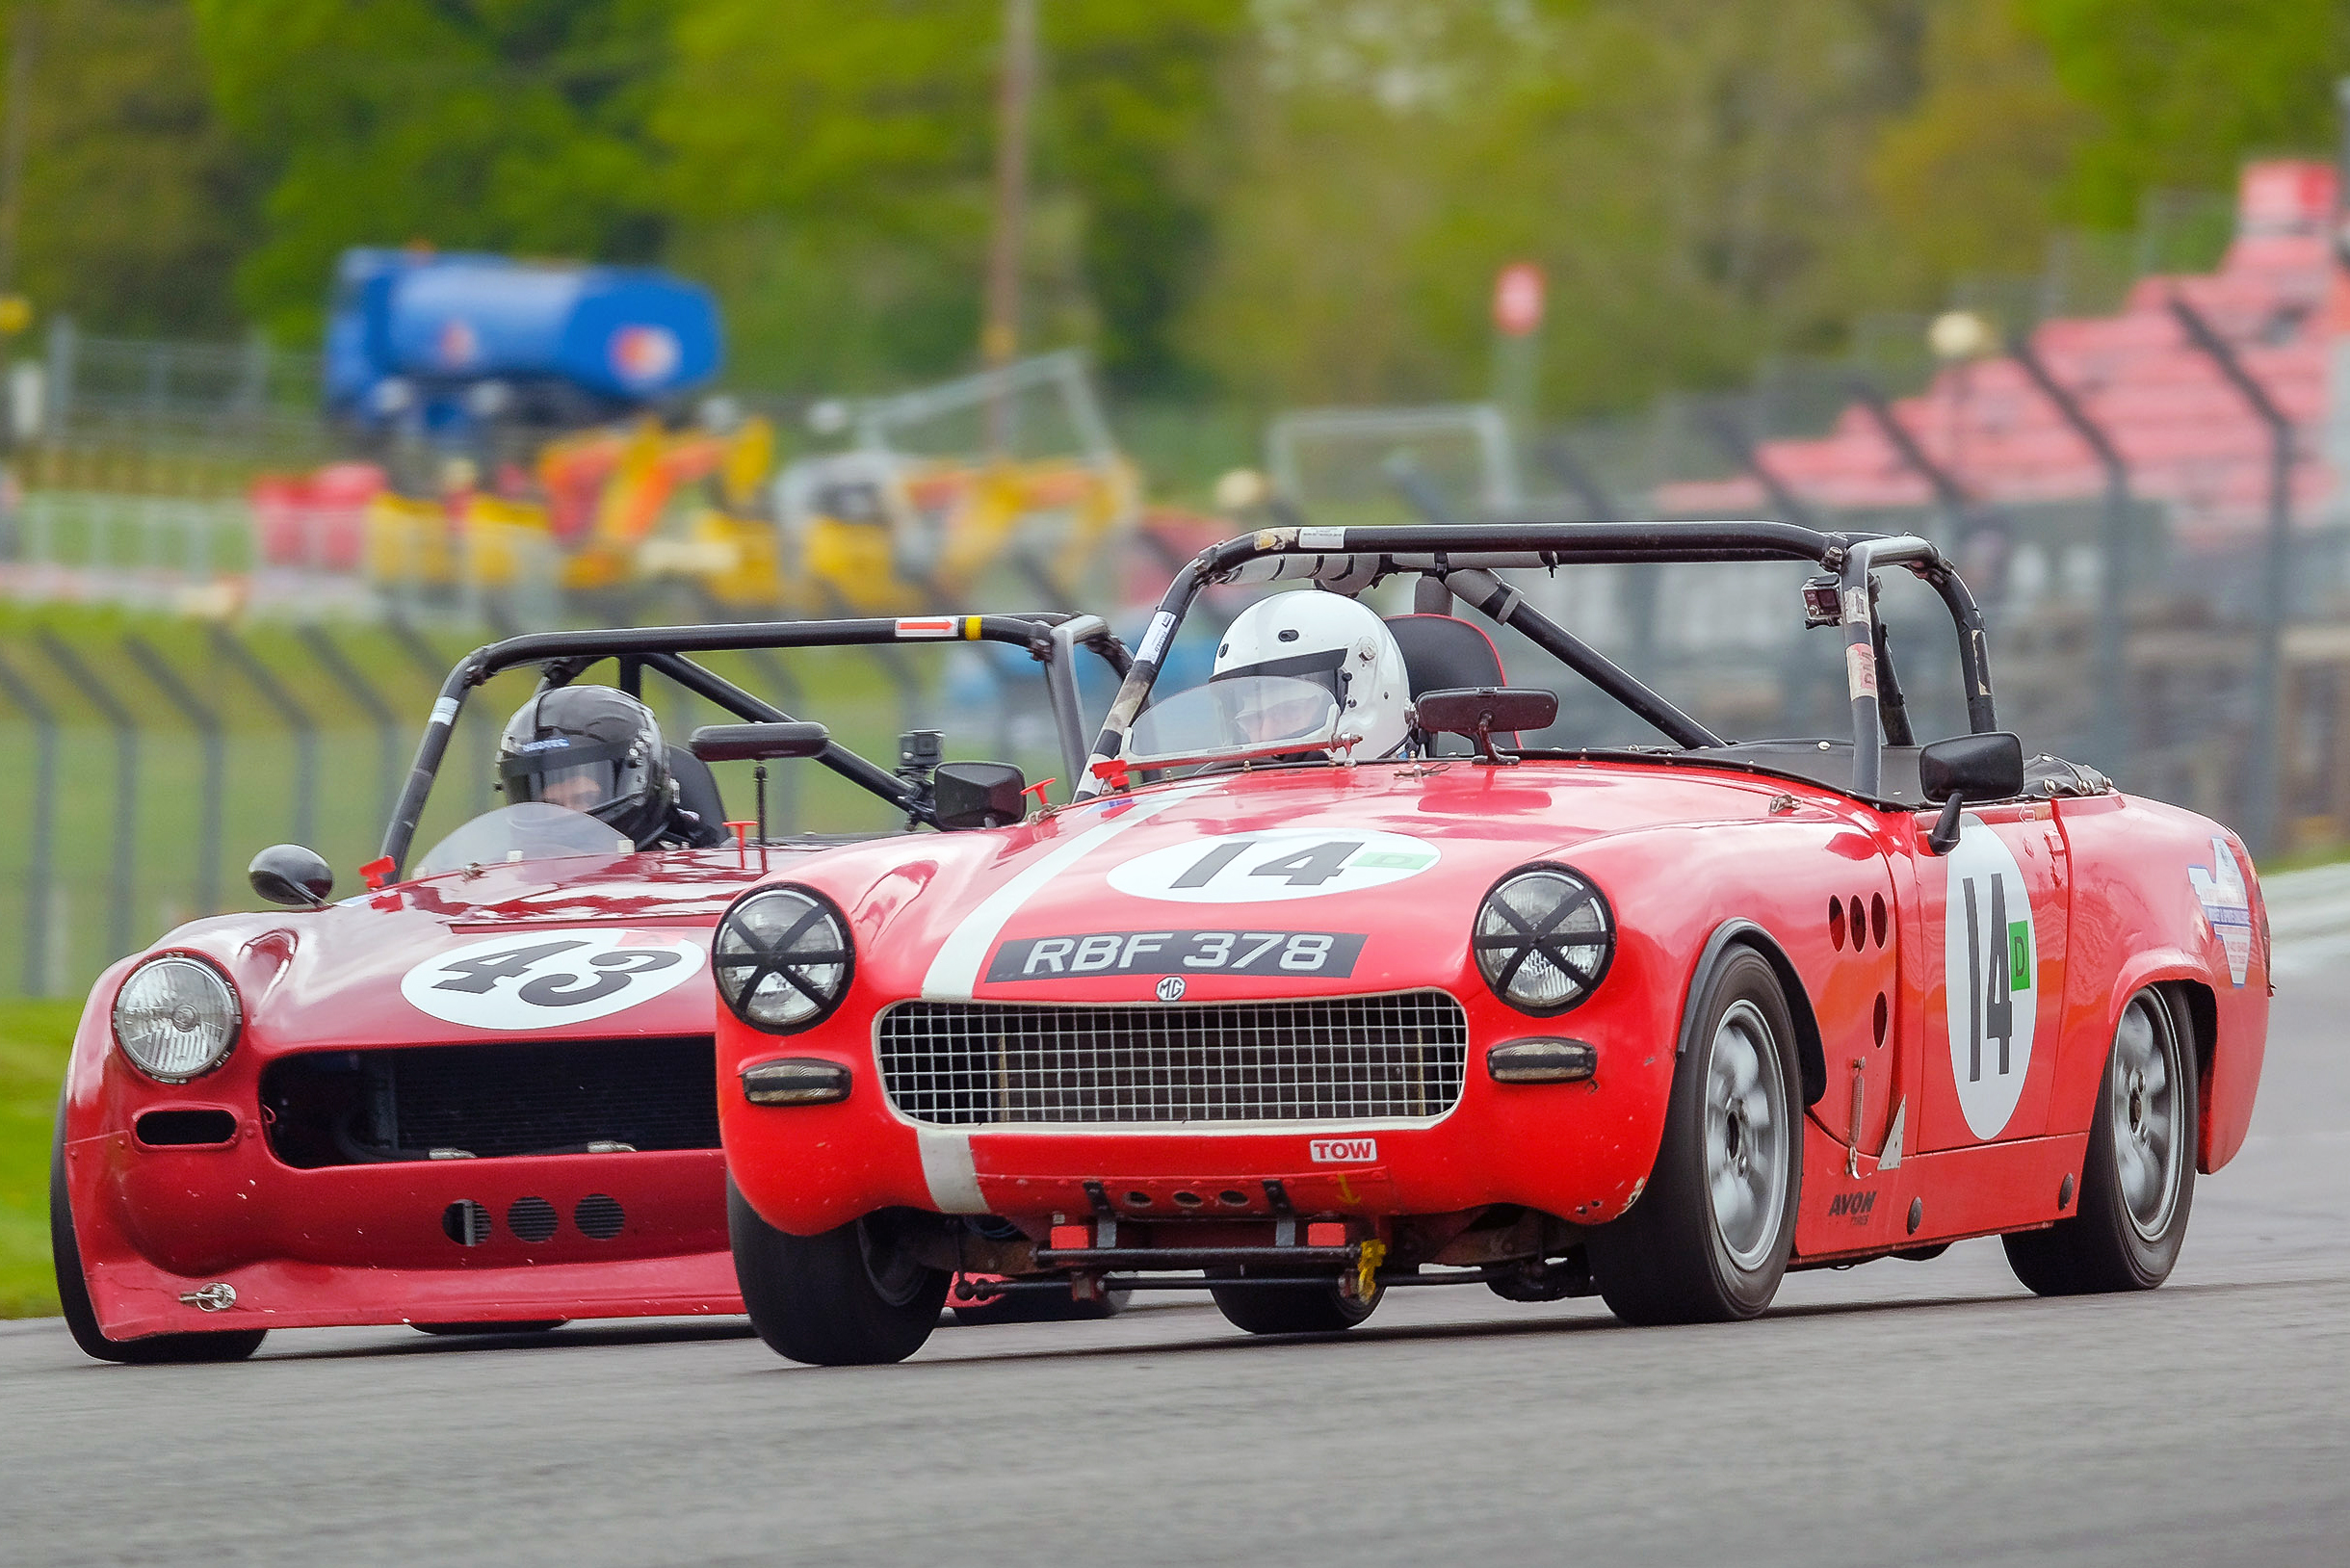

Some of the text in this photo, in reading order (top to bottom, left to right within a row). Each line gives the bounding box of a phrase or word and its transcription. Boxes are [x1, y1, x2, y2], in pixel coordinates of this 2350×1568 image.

[1168, 841, 1366, 889] 14
[1371, 854, 1414, 866] D
[431, 939, 682, 1007] 43
[1022, 931, 1335, 975] RBF 378
[2014, 935, 2025, 978] D
[1159, 978, 1183, 999] MG
[1962, 873, 2013, 1083] 14
[1314, 1141, 1372, 1160] TOW
[1828, 1190, 1877, 1216] AVON
